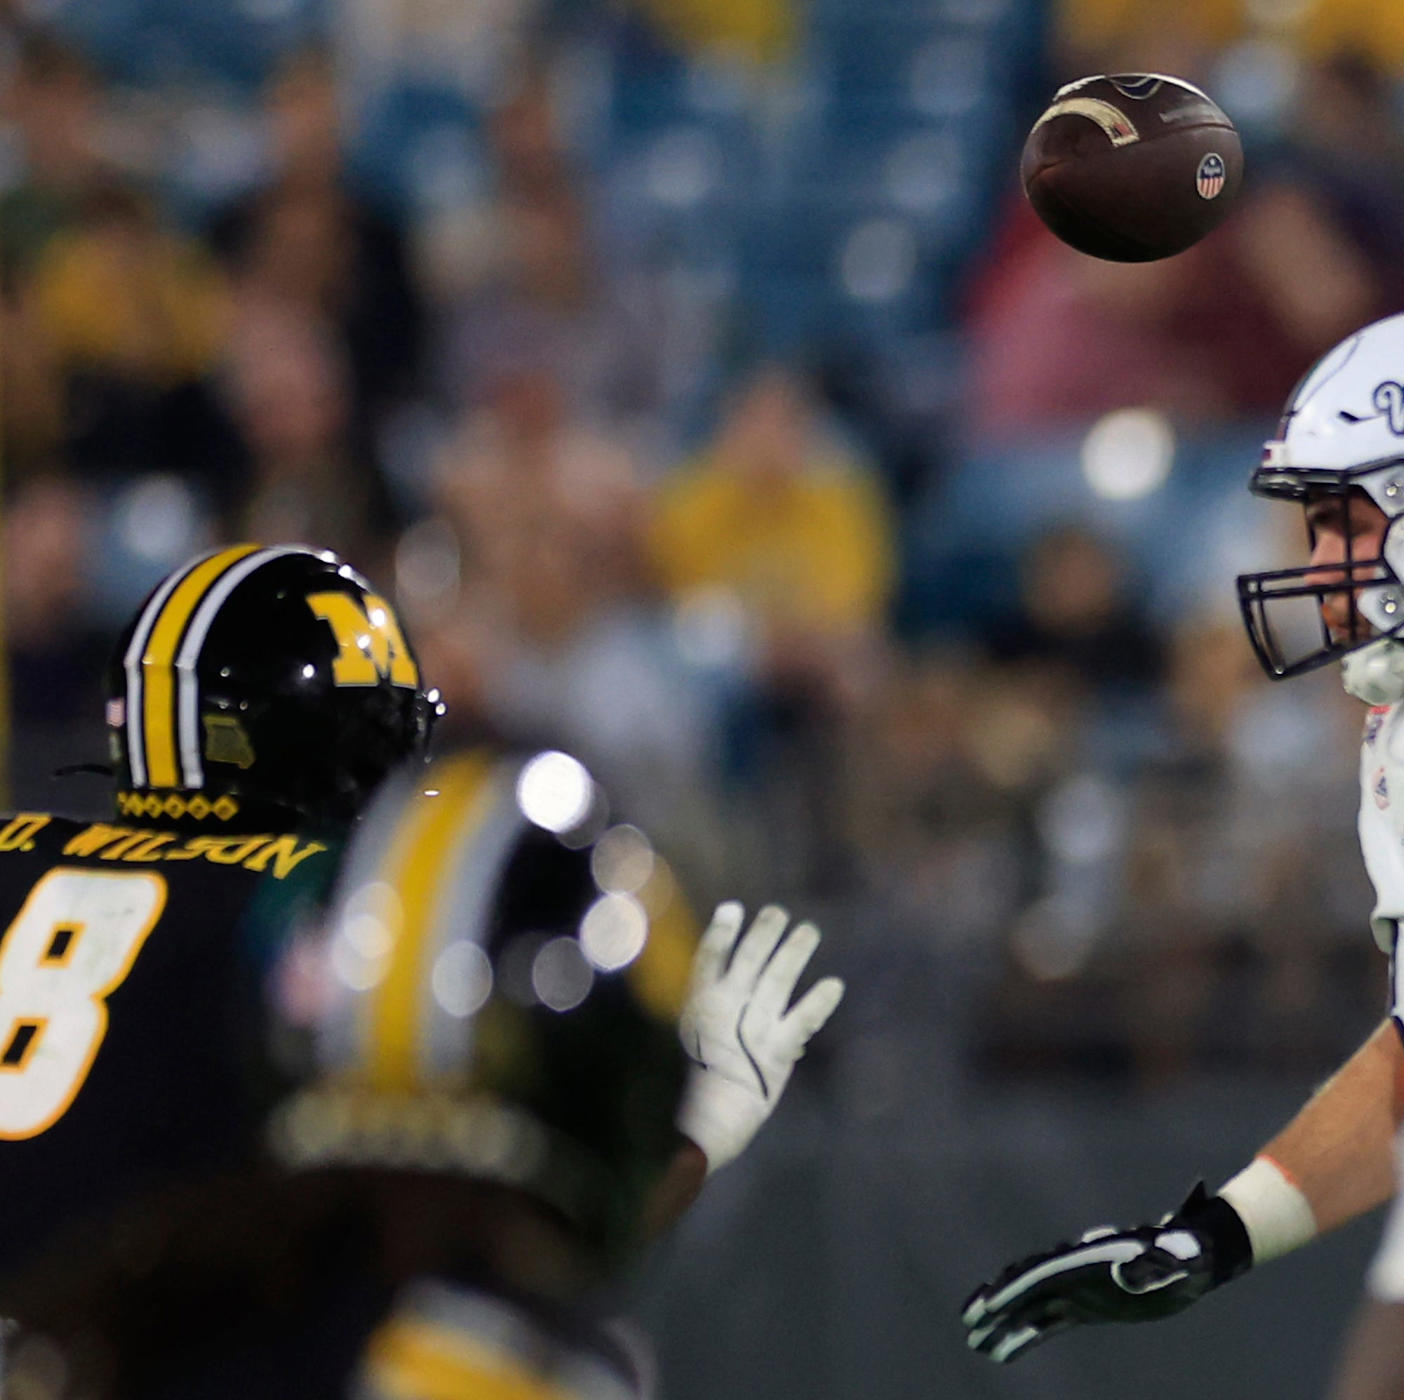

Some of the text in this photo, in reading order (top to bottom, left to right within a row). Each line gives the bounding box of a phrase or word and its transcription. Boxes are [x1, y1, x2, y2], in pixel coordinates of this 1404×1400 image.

[305, 592, 419, 688] M
[62, 822, 328, 880] WILSON
[0, 865, 168, 1140] 8
